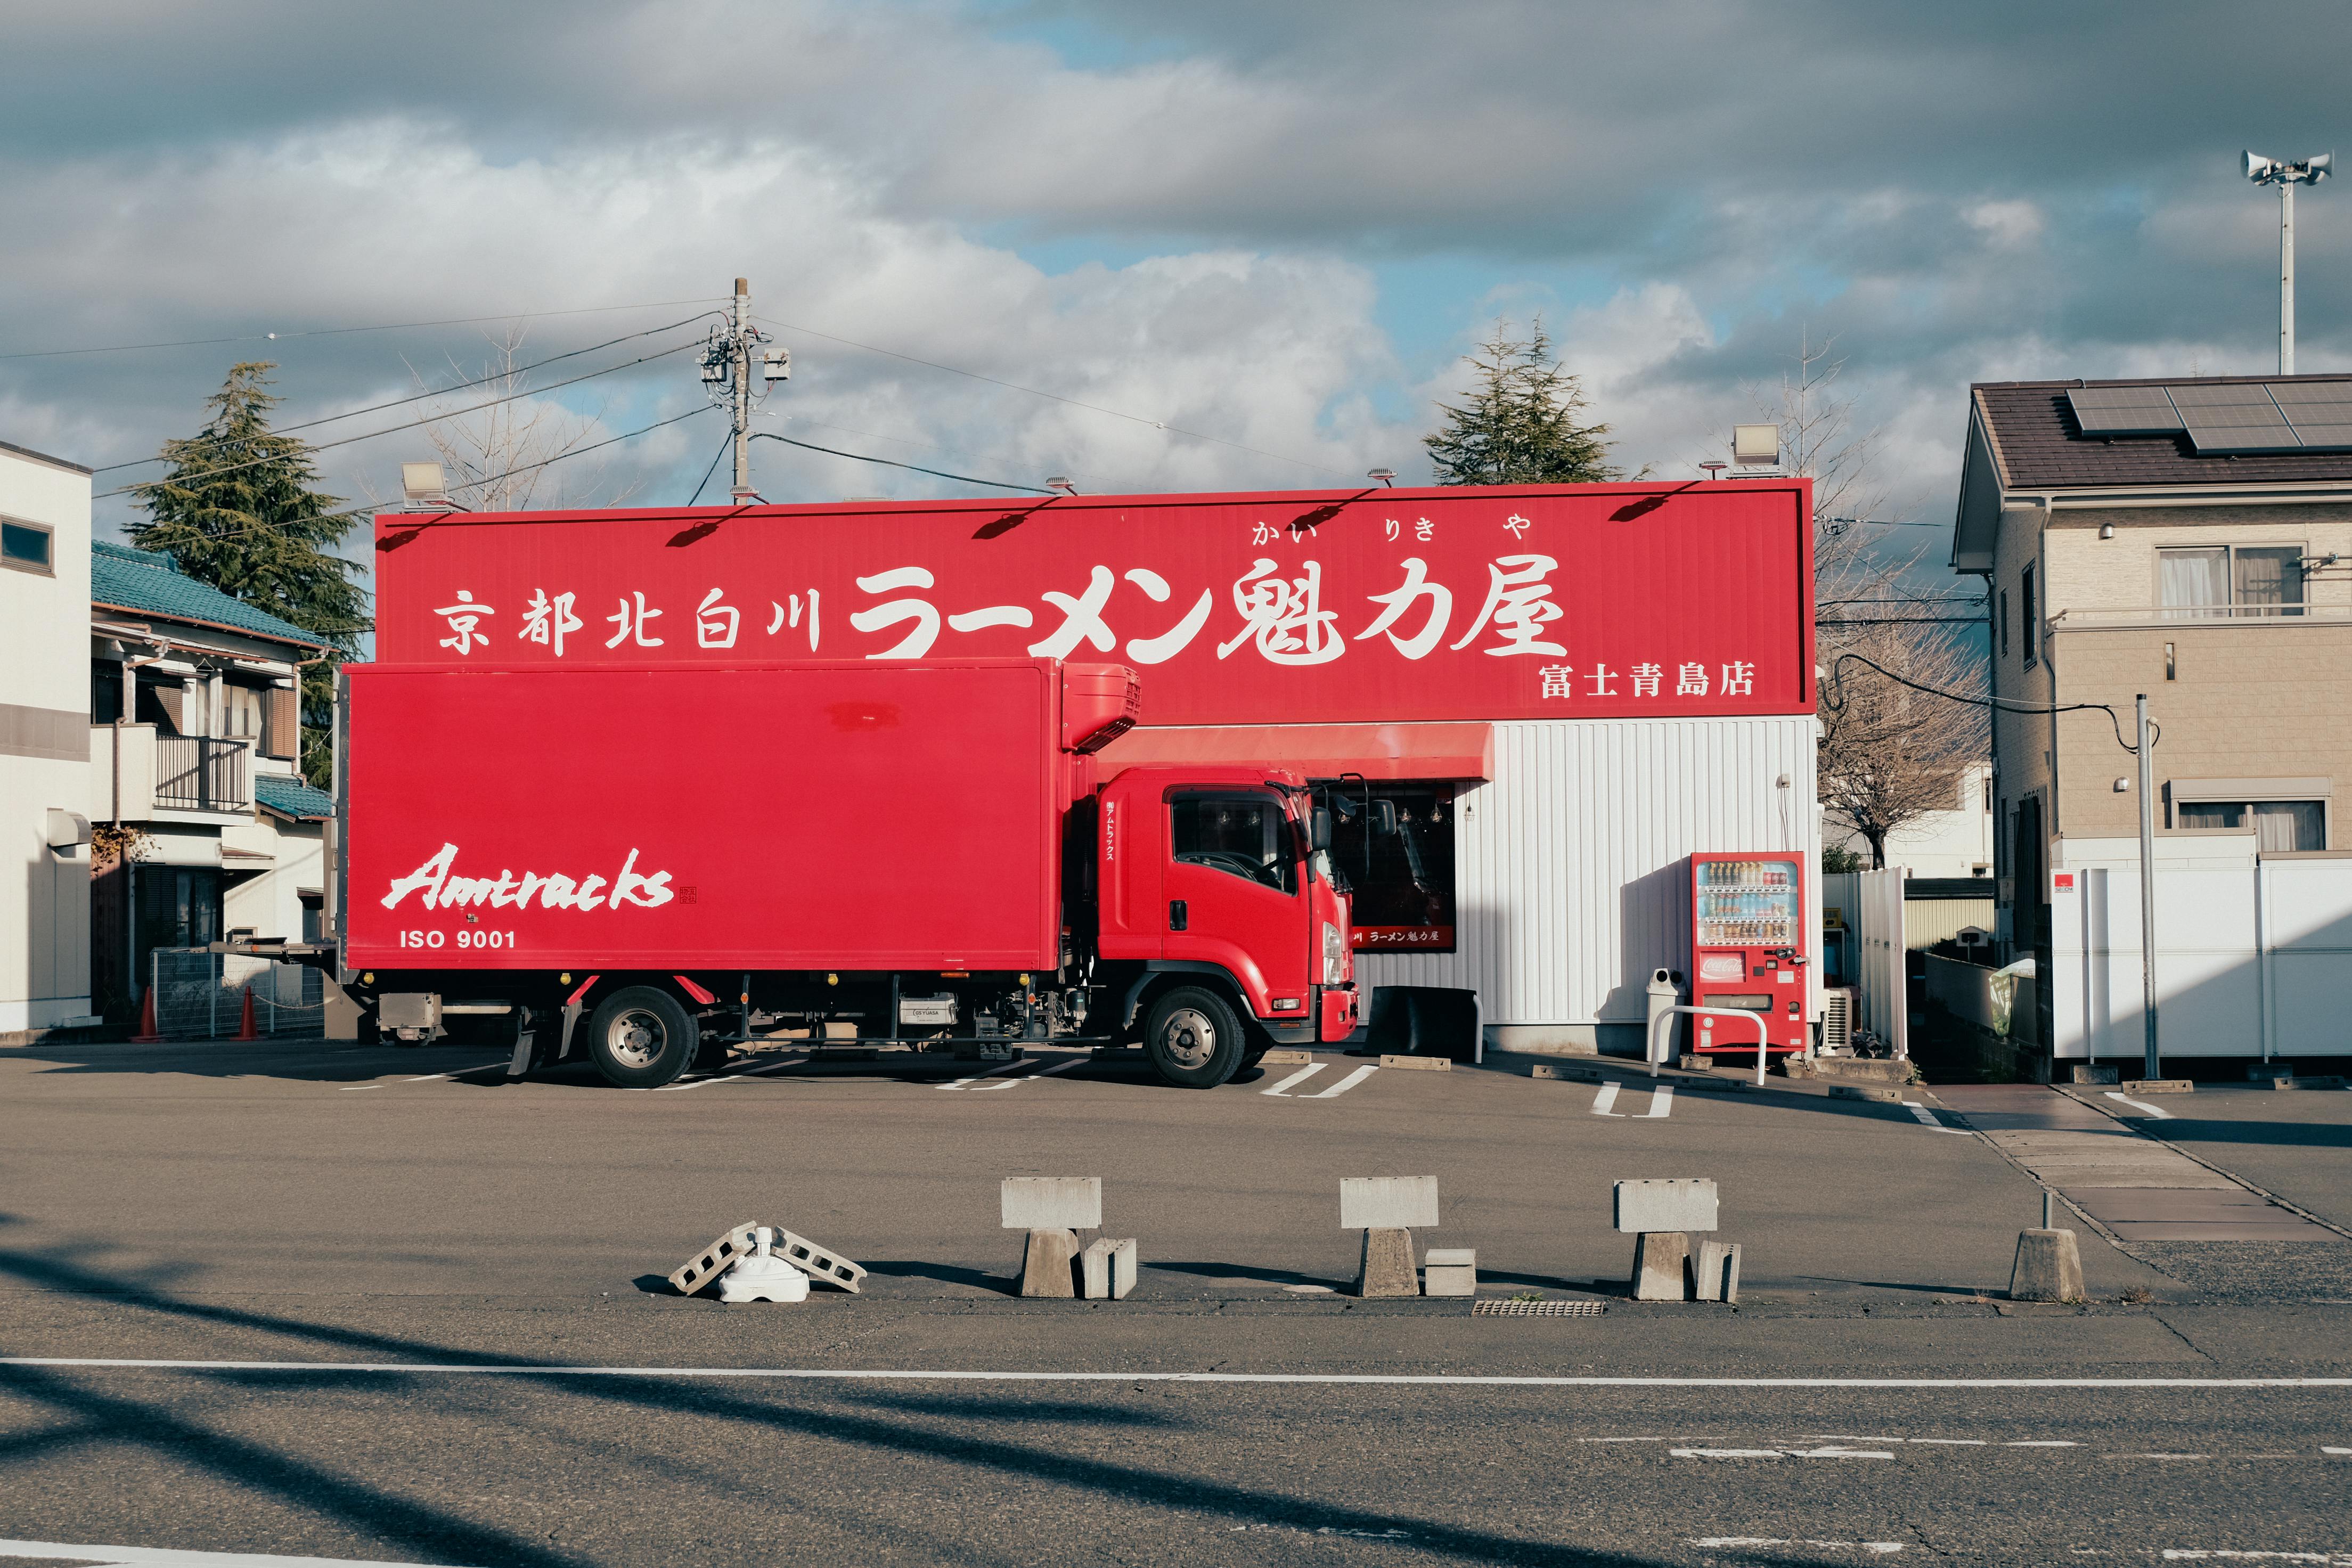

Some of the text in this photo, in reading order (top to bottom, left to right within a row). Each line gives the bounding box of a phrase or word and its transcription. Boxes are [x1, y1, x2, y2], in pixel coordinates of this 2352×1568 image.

[1252, 513, 1531, 545] かい りき や
[433, 554, 1573, 666] 京都北白川 ラーメン魁力屋
[1539, 660, 1755, 699] 富士青島店
[380, 842, 674, 911] Amtracks
[401, 930, 514, 948] ISO 9001
[1370, 931, 1439, 942] ラーメン魁力屋
